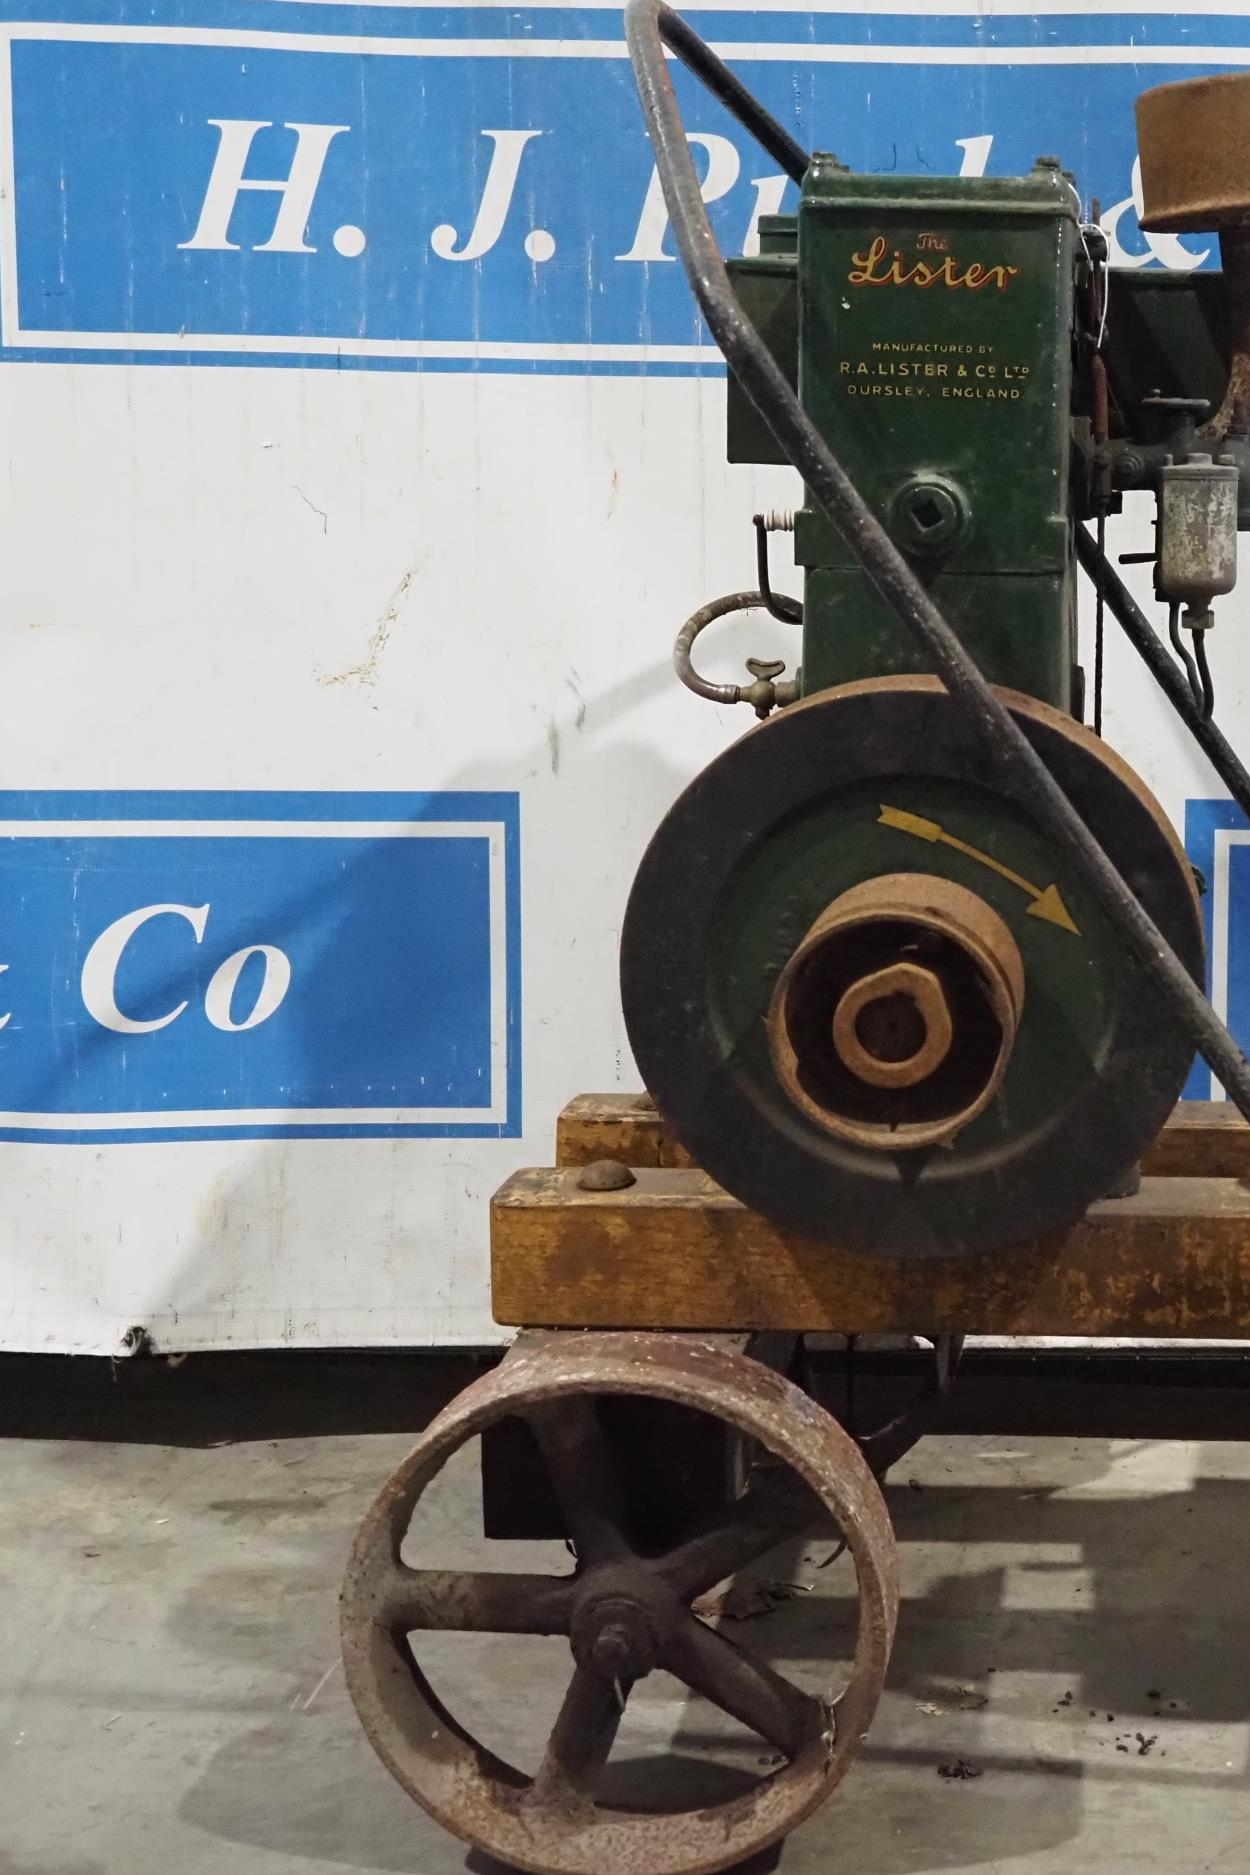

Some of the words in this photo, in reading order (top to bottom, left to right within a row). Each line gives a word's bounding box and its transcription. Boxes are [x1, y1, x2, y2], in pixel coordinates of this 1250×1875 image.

[177, 118, 366, 259] H.
[430, 129, 556, 263] J.
[916, 233, 948, 250] The
[848, 236, 1019, 289] Lister
[872, 342, 973, 354] MANUFACTURED
[979, 345, 994, 354] BY
[957, 364, 968, 377] &
[81, 903, 291, 1034] Co
